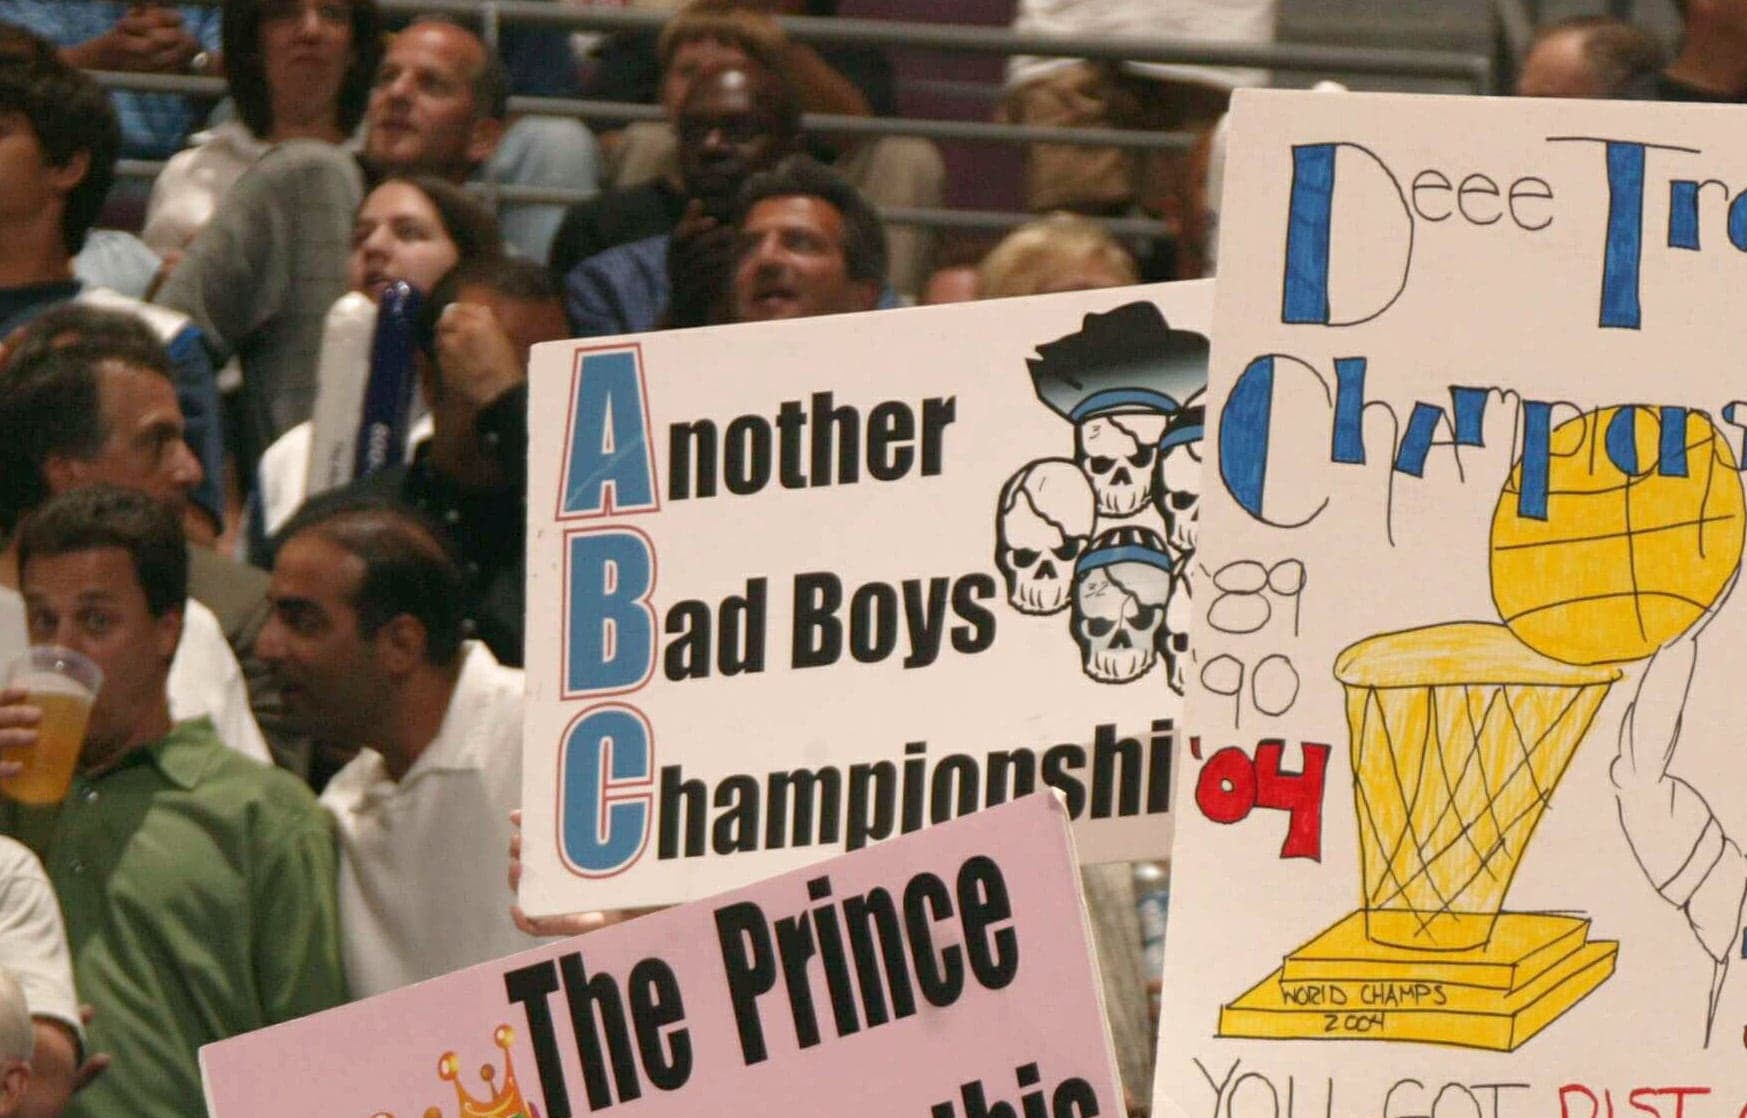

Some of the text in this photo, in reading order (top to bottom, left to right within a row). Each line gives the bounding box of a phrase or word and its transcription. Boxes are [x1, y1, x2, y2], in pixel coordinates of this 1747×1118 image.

[560, 525, 998, 700] Bad Boys
[555, 701, 1175, 880] Championshi
[1189, 735, 1332, 864] '04
[714, 855, 1020, 1066] Prince
[1323, 1012, 1386, 1032] 2004
[1360, 983, 1448, 1007] CHAMPS
